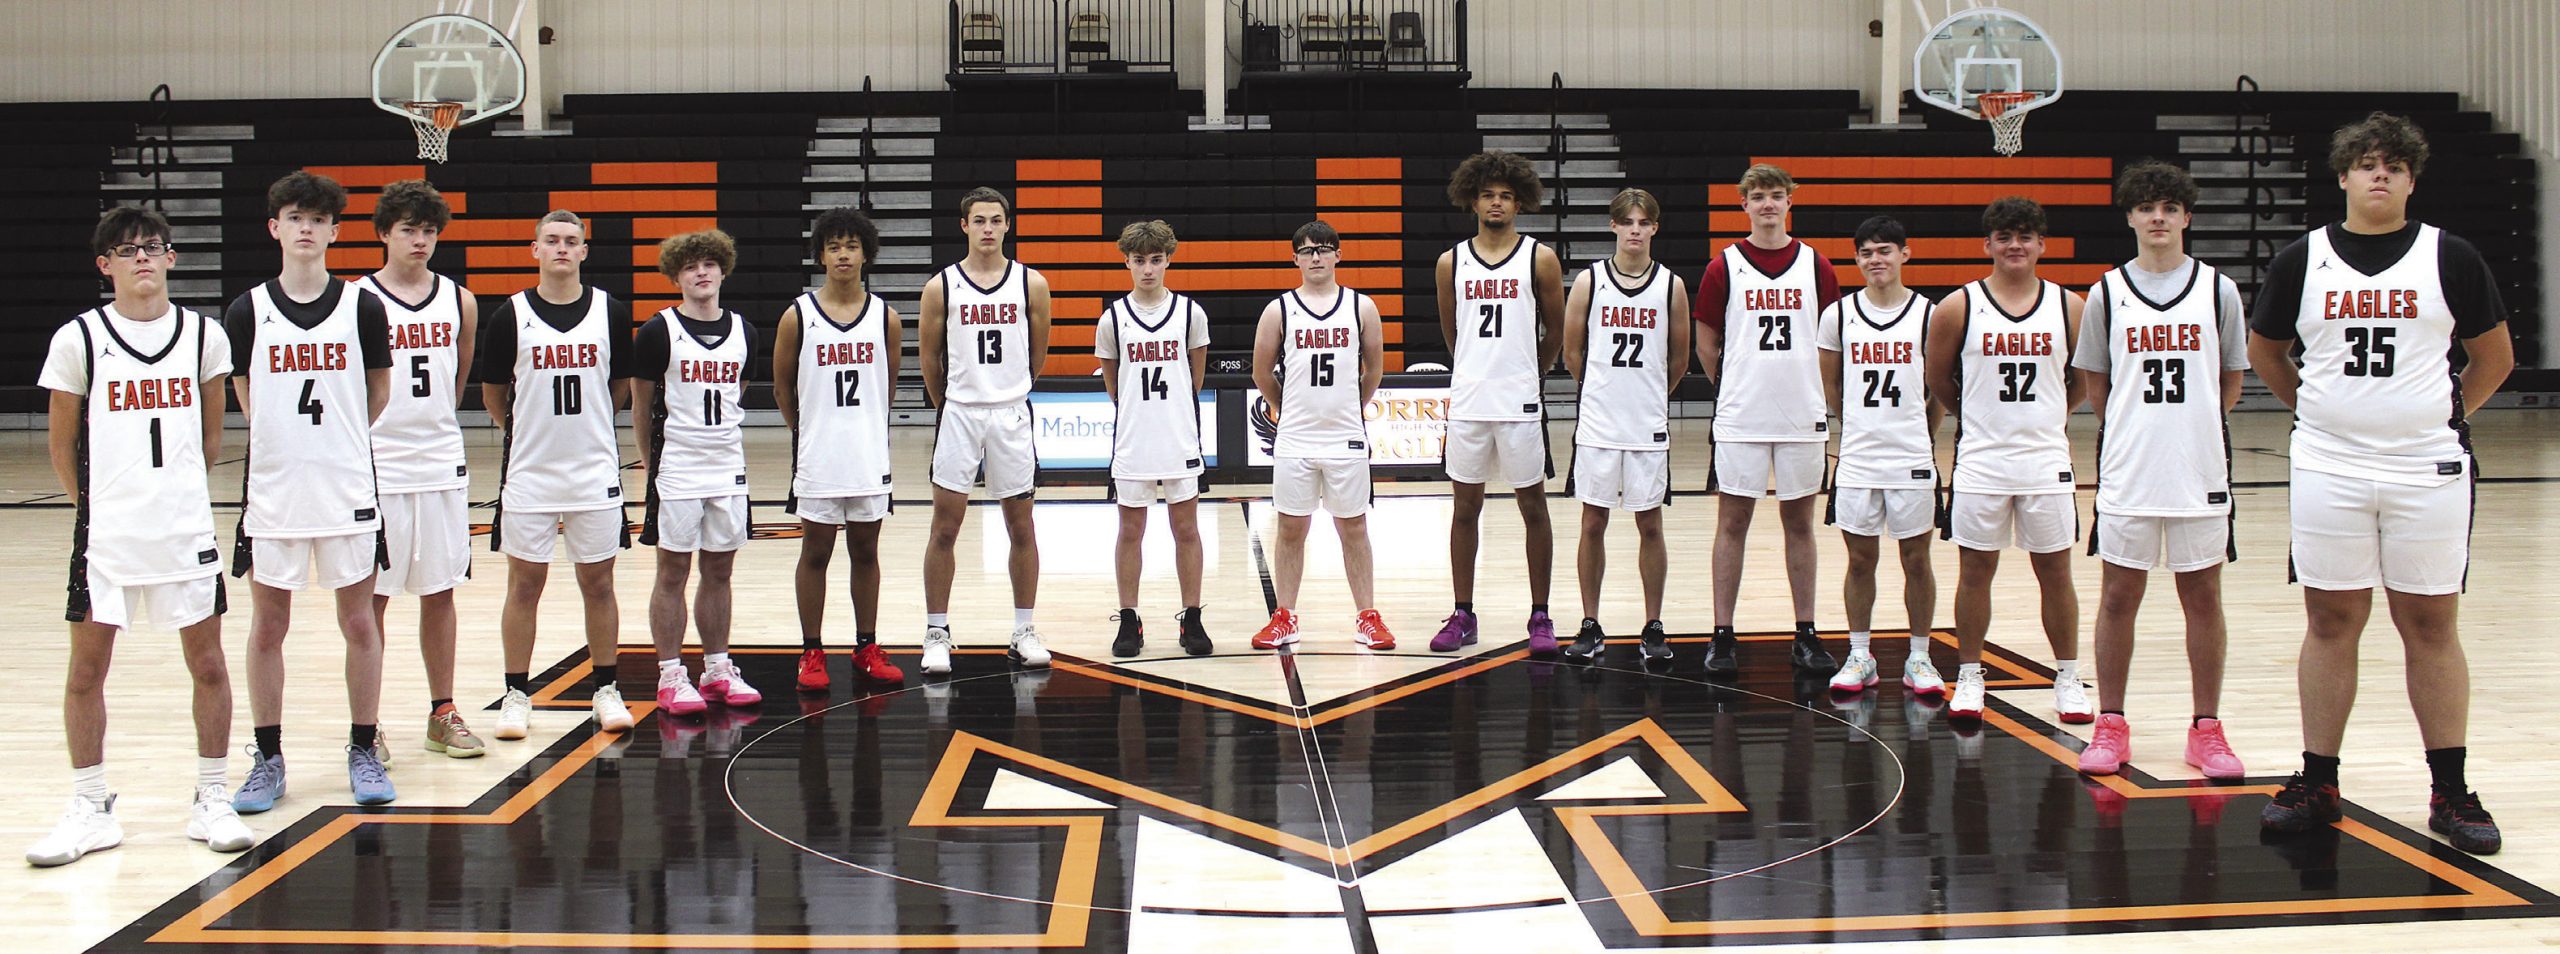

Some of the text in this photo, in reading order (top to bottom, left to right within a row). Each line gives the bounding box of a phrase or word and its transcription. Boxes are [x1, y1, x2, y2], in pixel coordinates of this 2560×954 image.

[1465, 278, 1519, 301] EAGLES
[1745, 288, 1802, 311] EAGLES
[2324, 289, 2418, 321] EAGLES
[959, 303, 1018, 326] EAGLES
[1478, 303, 1503, 338] 21
[1601, 305, 1658, 330] EAGLES
[977, 329, 1003, 365] 13
[1295, 327, 1350, 350] EAGLES
[1758, 315, 1792, 351] 23
[1982, 332, 2053, 357] EAGLES
[2126, 323, 2201, 354] EAGLES
[269, 342, 347, 374] EAGLES
[531, 343, 598, 370] EAGLES
[816, 342, 874, 367] EAGLES
[1126, 340, 1179, 363] EAGLES
[1220, 360, 1241, 370] POSS
[1611, 332, 1644, 369] 22
[1850, 341, 1913, 365] EAGLES
[2343, 326, 2397, 378] 35
[410, 355, 431, 398] 5
[680, 359, 740, 384] EAGLES
[1141, 366, 1169, 401] 14
[1310, 353, 1335, 387] 15
[1998, 362, 2037, 403] 32
[2142, 358, 2186, 404] 33
[108, 377, 192, 412] EAGLES
[297, 378, 324, 426] 4
[552, 374, 582, 416] 10
[834, 369, 860, 408] 12
[1862, 369, 1902, 408] 24
[703, 388, 722, 426] 11
[149, 417, 163, 468] 1
